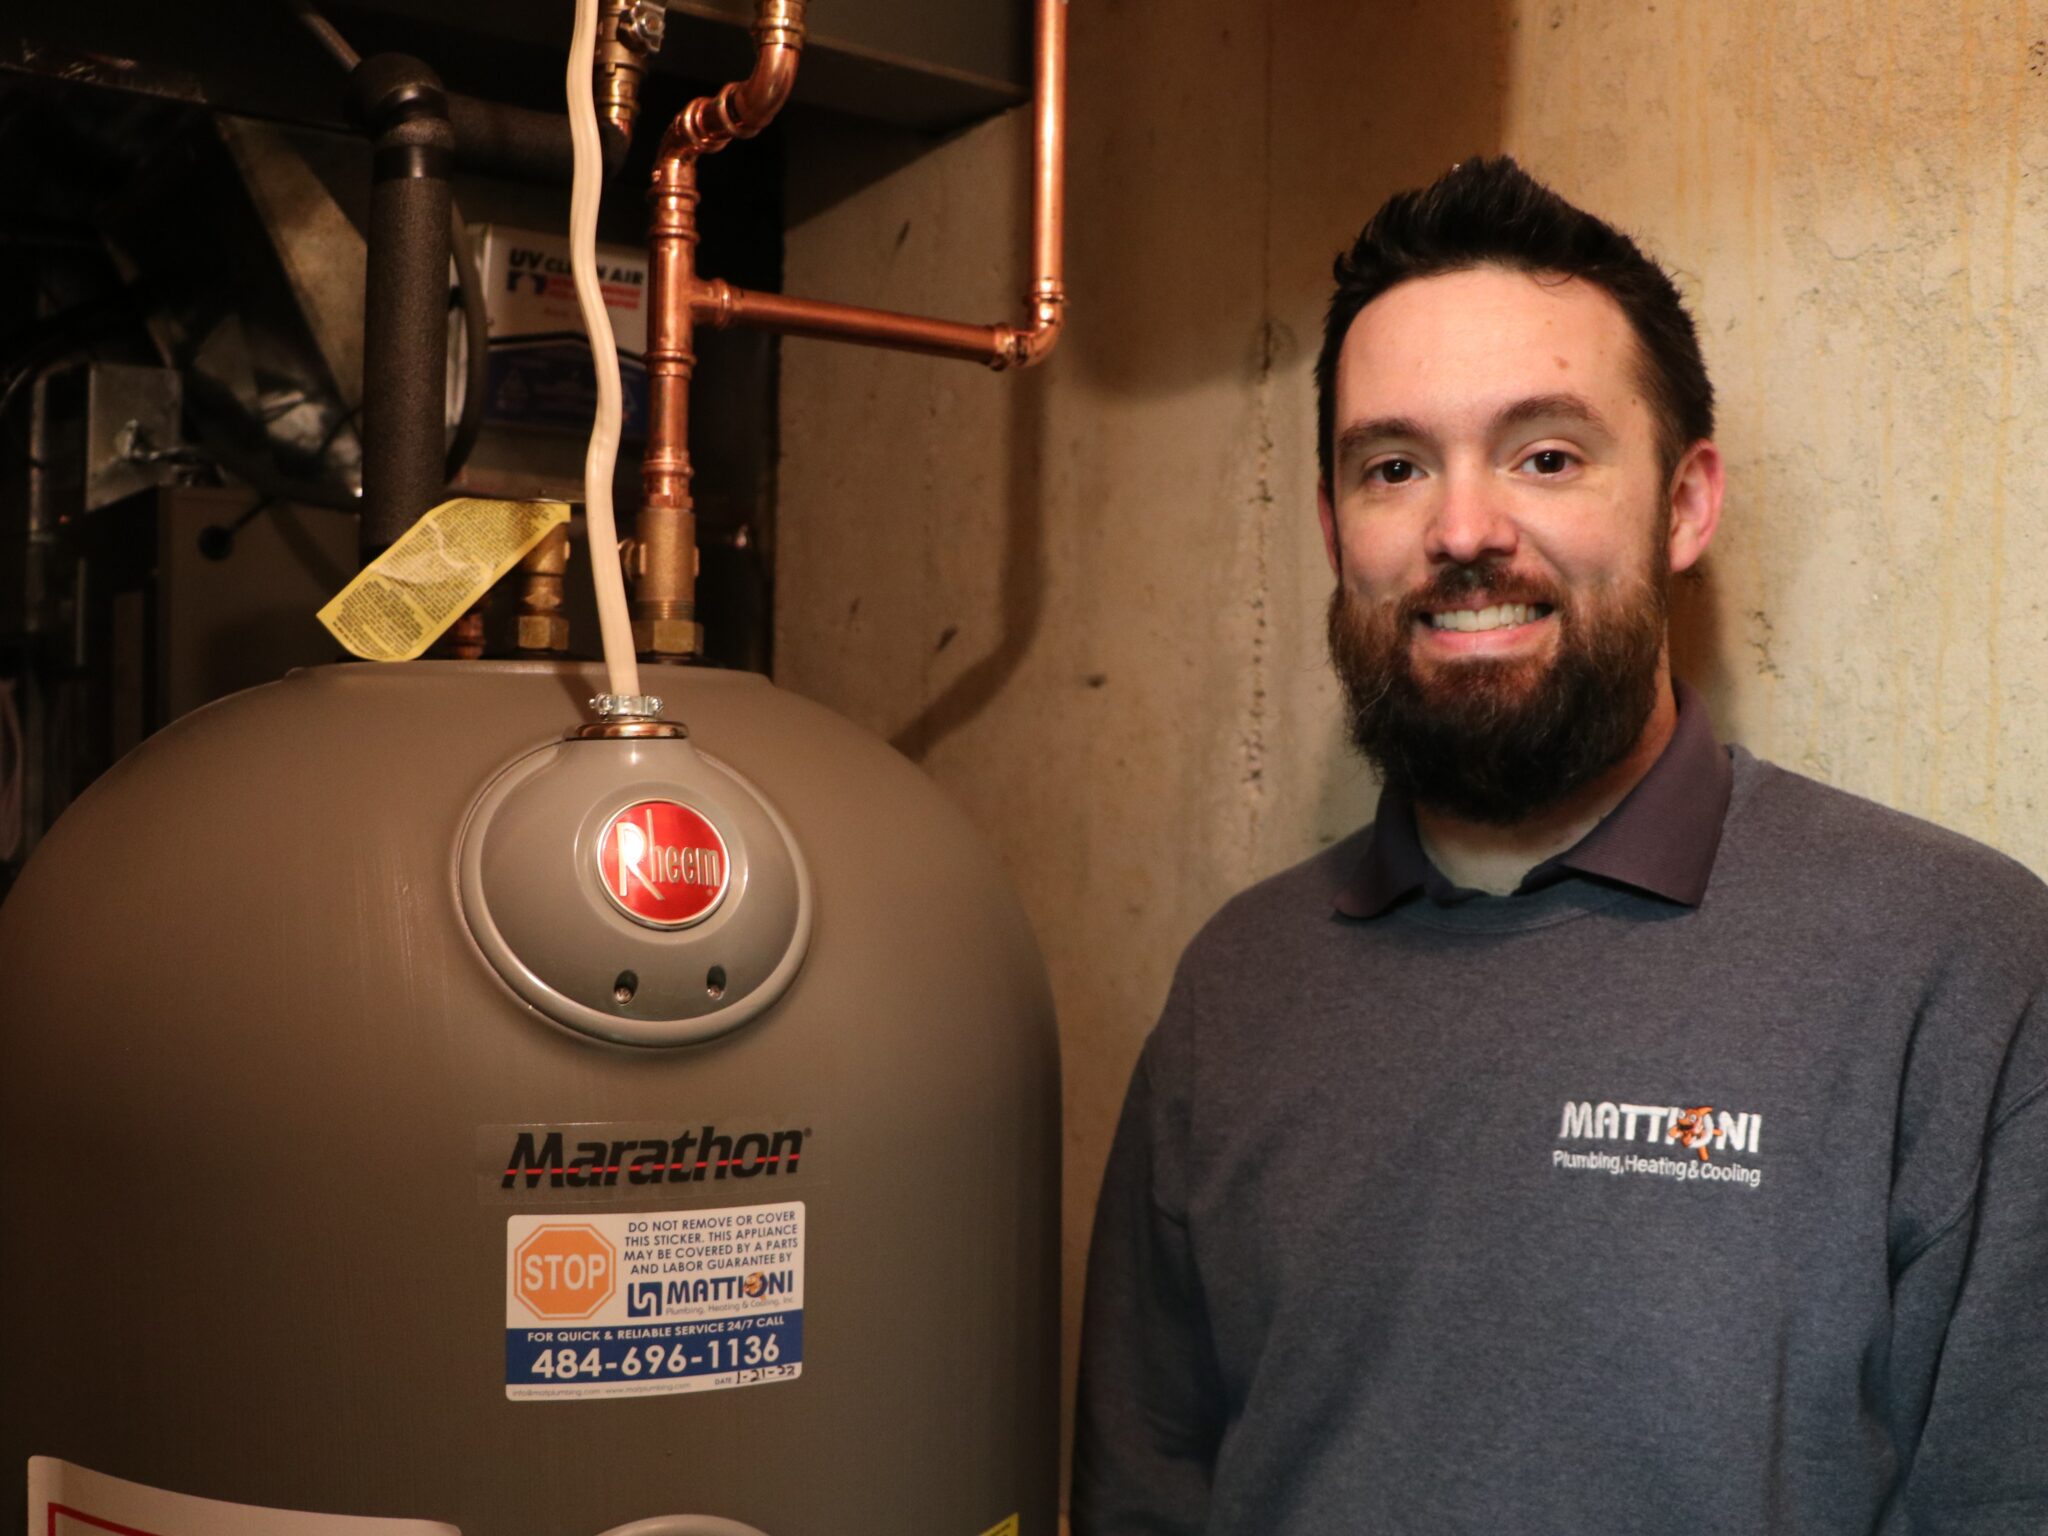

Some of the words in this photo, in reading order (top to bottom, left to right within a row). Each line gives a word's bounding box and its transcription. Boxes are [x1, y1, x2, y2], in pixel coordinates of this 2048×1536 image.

[509, 248, 544, 269] UV
[610, 267, 643, 285] AIR
[616, 808, 721, 900] Rheem
[1559, 1101, 1762, 1153] MATTIONI
[501, 1126, 804, 1188] Marathon
[625, 1236, 650, 1247] THIS
[654, 1232, 705, 1245] STICKER.
[709, 1231, 732, 1242] THIS
[736, 1224, 798, 1240] APPLIANCE
[629, 1222, 648, 1233] DO
[652, 1220, 678, 1231] NOT
[682, 1216, 733, 1229] REMOVE
[736, 1215, 753, 1225] OR
[756, 1211, 796, 1224] COVER
[624, 1249, 653, 1261] MAY
[658, 1248, 671, 1259] BE
[675, 1244, 732, 1258] COVERED
[736, 1242, 752, 1254] BY
[754, 1241, 763, 1251] A
[766, 1238, 798, 1249] PARTS
[630, 1264, 659, 1275] AND
[663, 1260, 703, 1273] LABOR
[707, 1255, 776, 1270] GUARANTEE
[779, 1252, 792, 1263] BY
[524, 1253, 606, 1291] STOP
[667, 1270, 793, 1305] MATTIONI
[527, 1332, 554, 1343] FOR
[557, 1330, 600, 1343] QUICK
[604, 1330, 613, 1341] &
[617, 1327, 672, 1341] RELIABLE
[675, 1322, 725, 1336] SERVICE
[727, 1319, 753, 1332] 24/7
[756, 1315, 785, 1328] CALL
[531, 1333, 780, 1379] 484-696-1136
